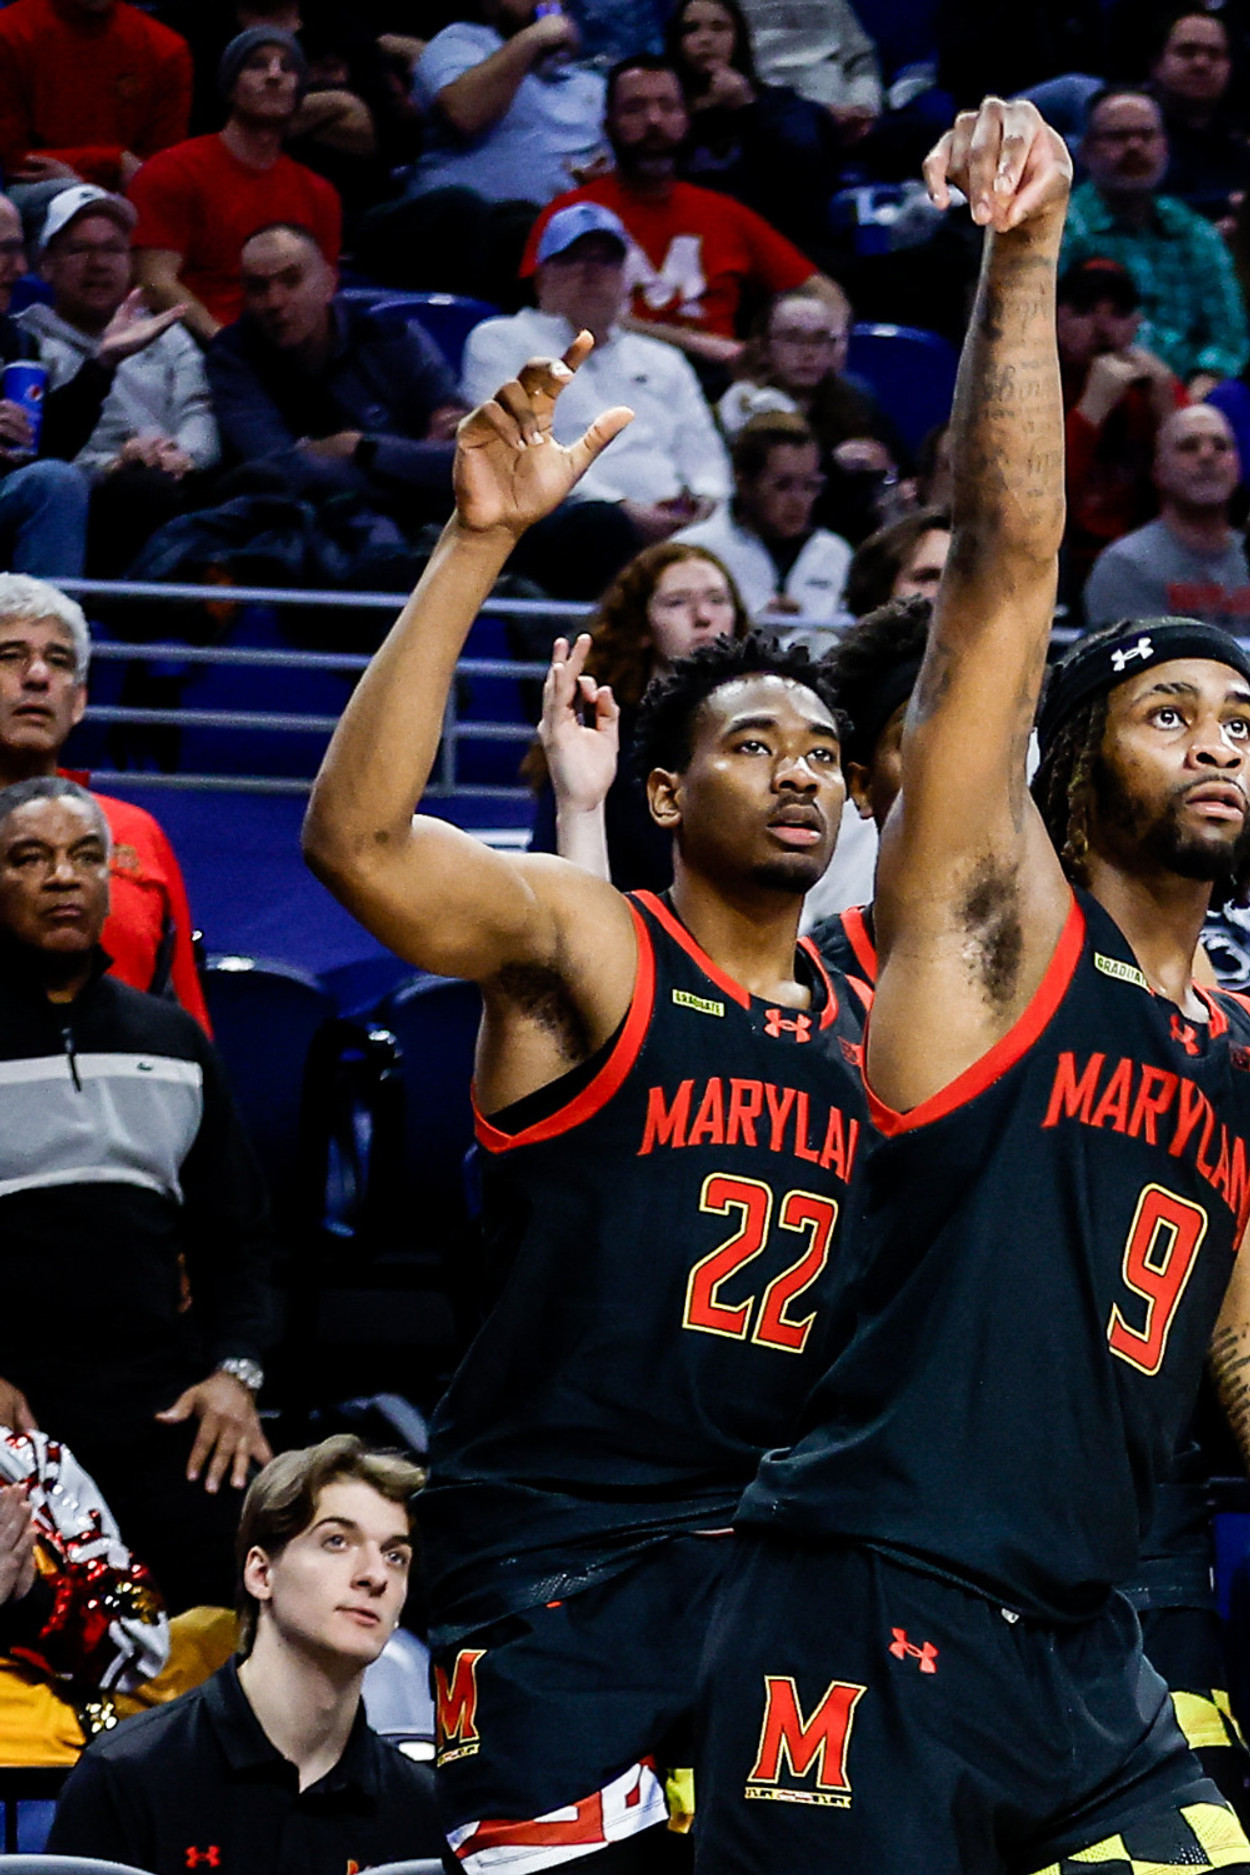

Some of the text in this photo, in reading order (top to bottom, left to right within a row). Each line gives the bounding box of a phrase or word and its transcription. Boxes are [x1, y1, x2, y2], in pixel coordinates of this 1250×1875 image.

[1097, 956, 1146, 987] GRADUA
[636, 1077, 861, 1182] MARYLA
[682, 1172, 838, 1354] 22
[1106, 1182, 1208, 1376] 9
[433, 1649, 487, 1753] M
[747, 1674, 868, 1792] M
